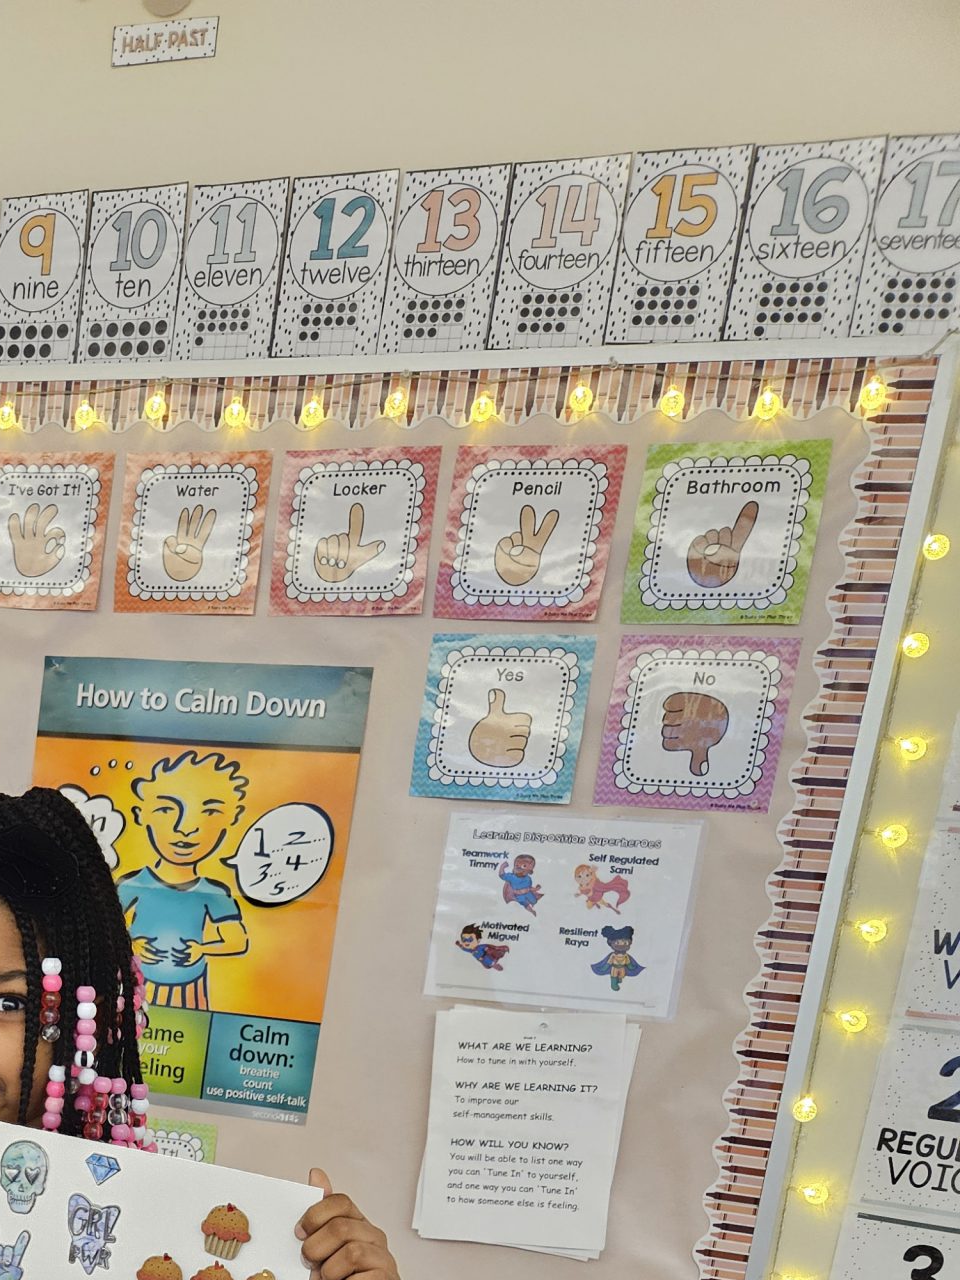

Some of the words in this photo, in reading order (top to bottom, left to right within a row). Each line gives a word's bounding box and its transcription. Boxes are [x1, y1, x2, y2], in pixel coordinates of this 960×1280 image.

[122, 33, 164, 53] HALF
[168, 29, 208, 49] PAST
[646, 173, 719, 240] 15
[770, 168, 852, 237] 16
[416, 188, 481, 254] 13
[532, 182, 600, 248] 14
[207, 202, 258, 264] 11
[310, 196, 376, 260] 12
[20, 213, 56, 276] 9
[110, 208, 167, 271] 10
[756, 239, 847, 260] sixteen
[518, 250, 600, 272] fourteen
[635, 239, 714, 264] fifteen
[194, 264, 262, 287] eleven
[300, 261, 370, 285] twelve
[404, 255, 480, 277] thirteen
[13, 277, 59, 299] nine
[116, 275, 151, 298] ten
[8, 484, 33, 496] I've
[38, 484, 59, 496] Got
[63, 483, 81, 496] It!
[177, 484, 219, 498] Water
[333, 482, 385, 497] Locker
[513, 481, 562, 496] Pencil
[687, 480, 780, 494] Bathroom
[496, 668, 524, 682] Yes
[694, 672, 715, 686] No
[77, 683, 132, 708] How
[140, 688, 167, 710] to
[175, 689, 237, 714] Calm
[246, 691, 325, 718] Down
[463, 850, 509, 859] Teamwork
[589, 854, 607, 863] Self
[609, 855, 659, 865] Regulated
[470, 860, 498, 871] Timmy
[610, 865, 633, 874] Sami
[481, 922, 529, 932] Motivated
[488, 932, 519, 942] Miguel
[559, 927, 598, 937] Resilient
[565, 938, 589, 947] Raya
[143, 1027, 184, 1043] ame
[241, 1025, 289, 1045] Calm
[230, 1045, 294, 1068] down:
[459, 1042, 488, 1050] WHAT
[516, 1043, 530, 1051] WE
[535, 1043, 592, 1052] LEARNING?
[240, 1066, 279, 1078] breathe
[243, 1079, 272, 1089] count
[482, 1082, 500, 1090] ARE
[505, 1083, 519, 1091] WE
[524, 1084, 576, 1092] LEARNING
[580, 1085, 597, 1093] IT?
[207, 1087, 223, 1097] use
[226, 1089, 264, 1102] positive
[267, 1094, 306, 1107] self-talk
[479, 1140, 503, 1148] WILL
[508, 1141, 528, 1149] YOU
[533, 1142, 568, 1150] KNOW?
[72, 1206, 120, 1243] GRL
